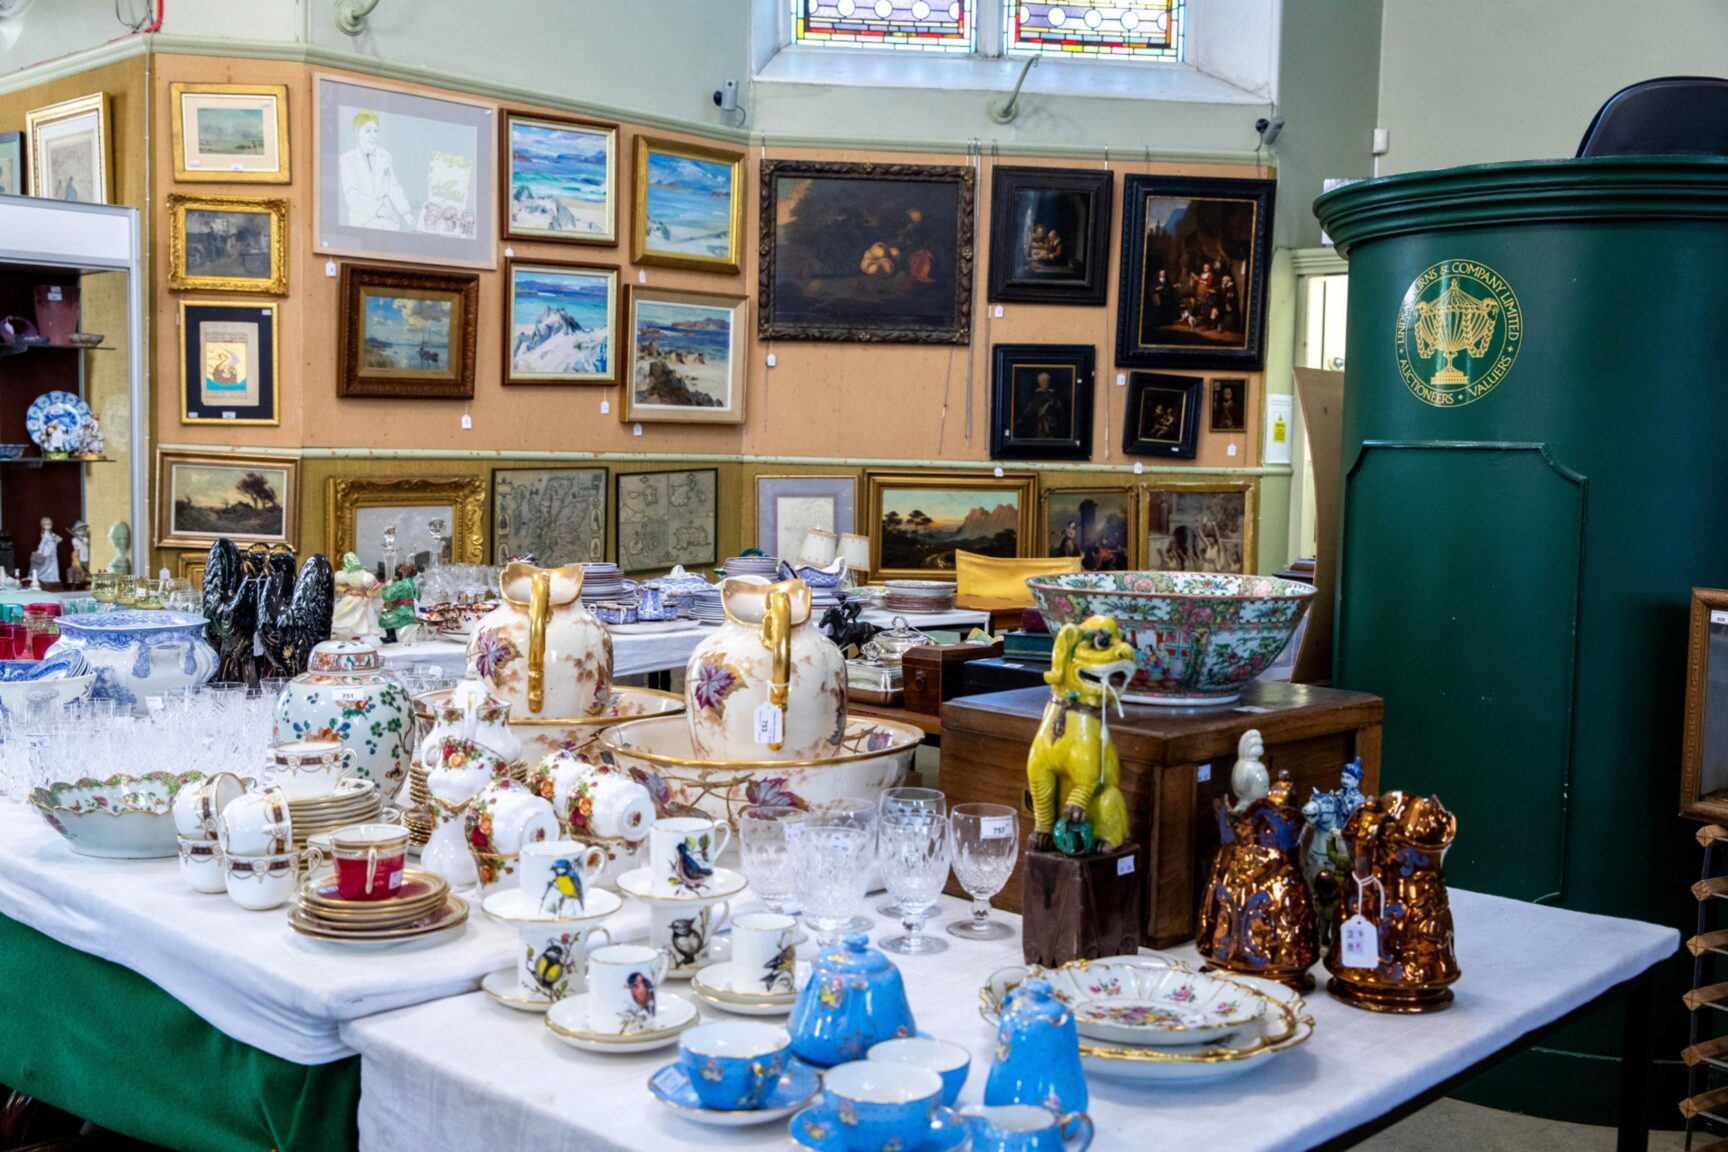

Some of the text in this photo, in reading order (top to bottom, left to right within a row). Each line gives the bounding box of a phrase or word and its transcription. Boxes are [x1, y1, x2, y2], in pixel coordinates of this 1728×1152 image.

[1440, 264, 1450, 275] &
[1452, 262, 1507, 293] COMPANY
[1500, 291, 1520, 341] LIMITED
[1399, 356, 1512, 405] AUCTIONEERS VALUERS
